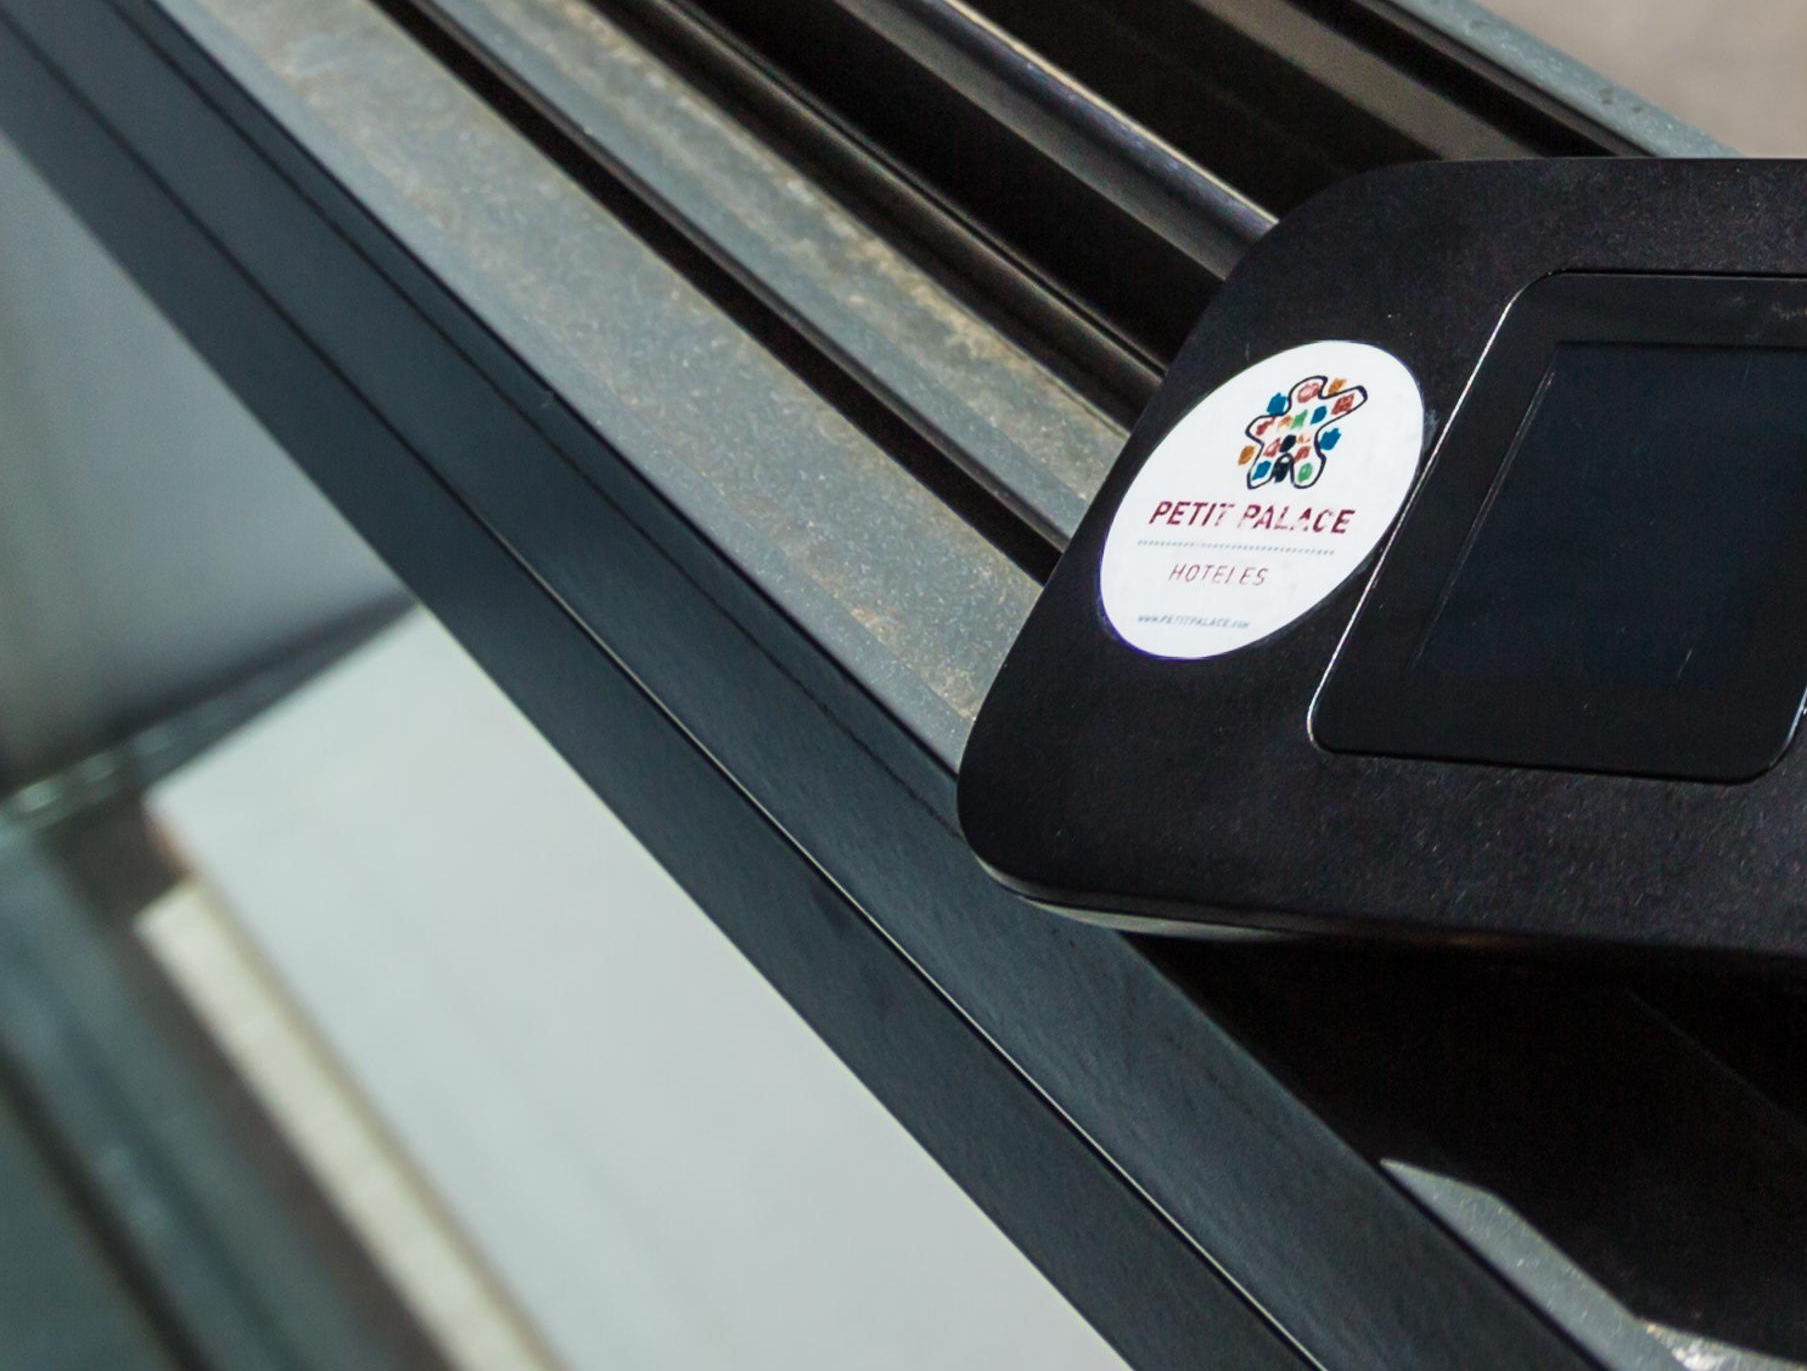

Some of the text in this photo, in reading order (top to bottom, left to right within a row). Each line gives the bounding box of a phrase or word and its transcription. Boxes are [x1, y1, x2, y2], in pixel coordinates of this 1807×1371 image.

[1148, 500, 1356, 534] PETIT PALACE
[1168, 562, 1269, 587] HOTELES
